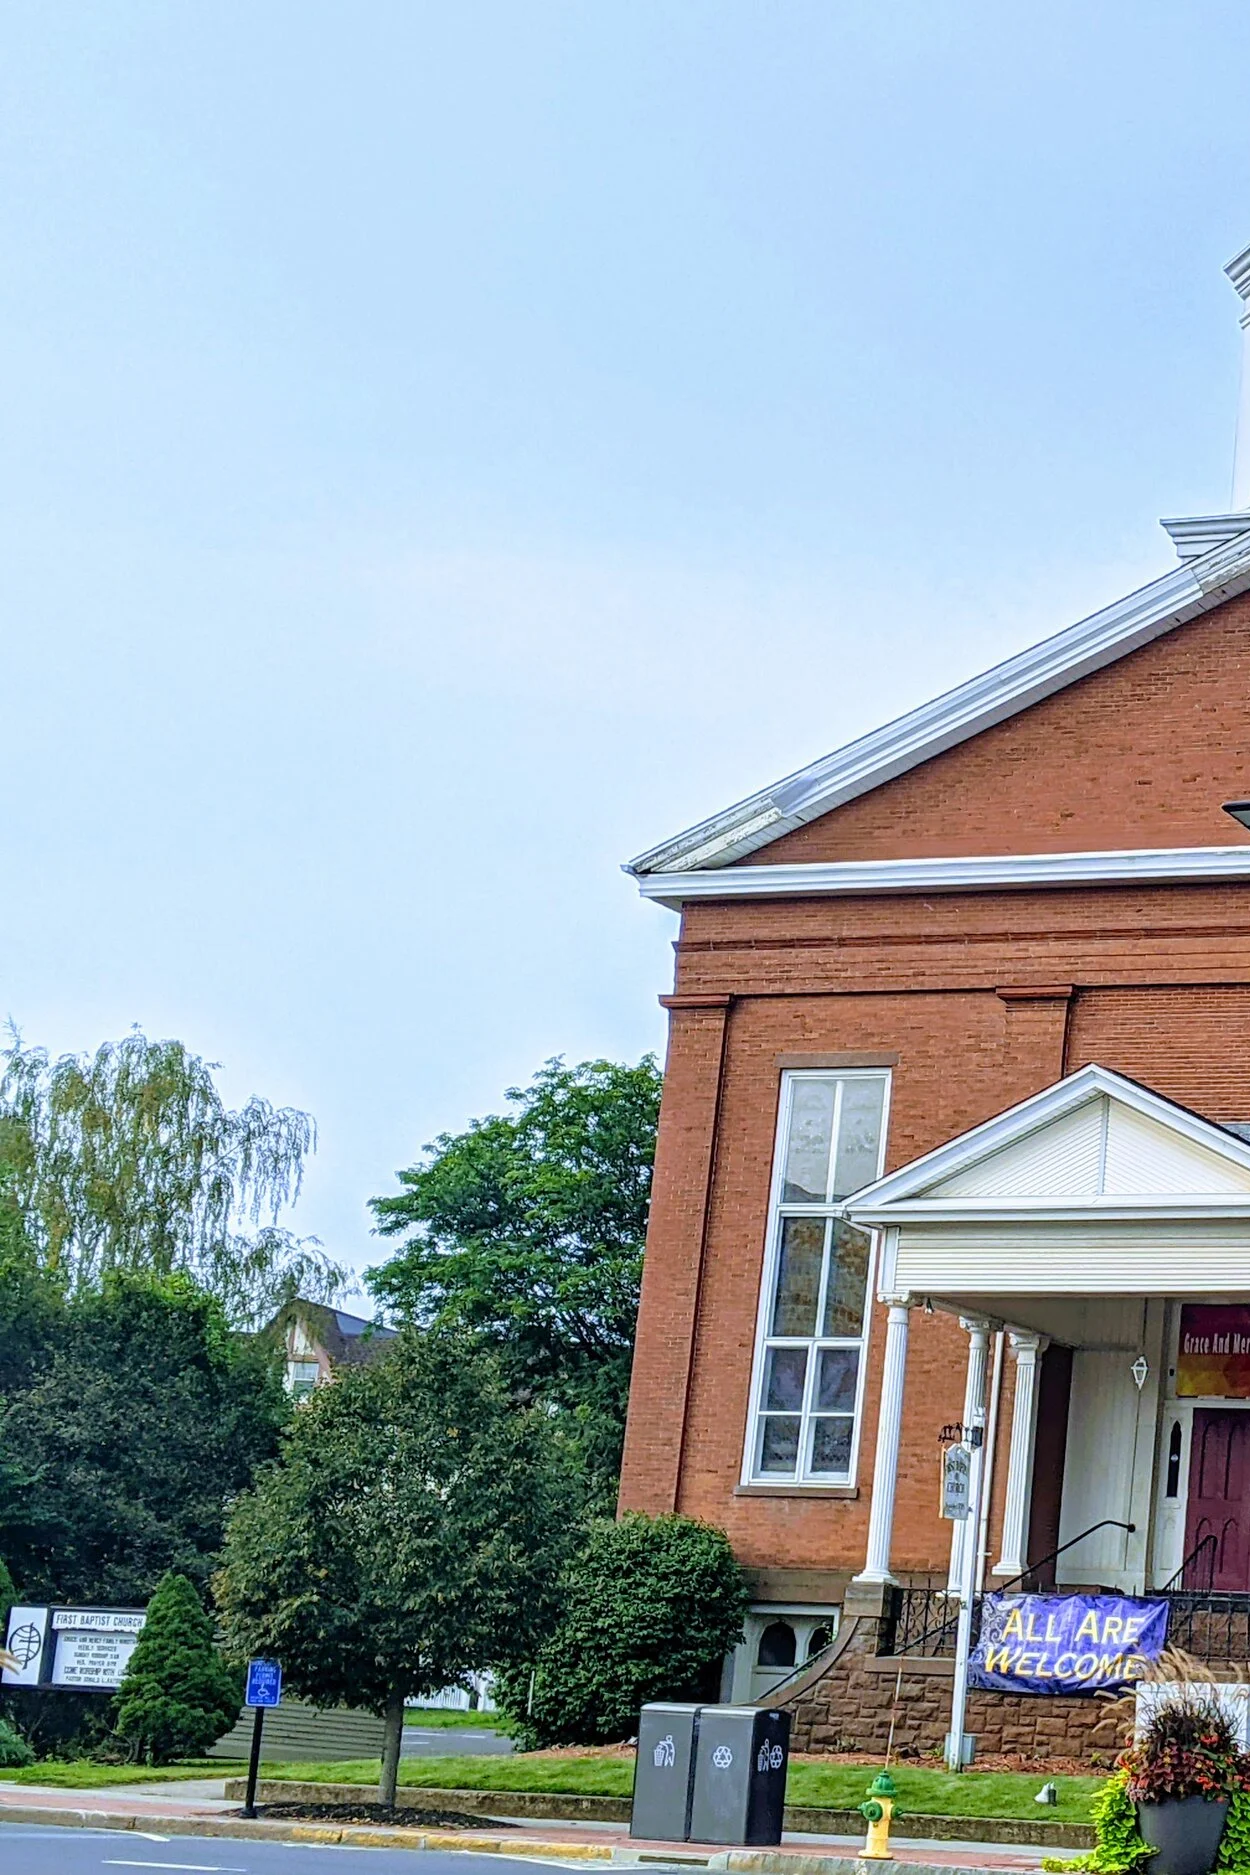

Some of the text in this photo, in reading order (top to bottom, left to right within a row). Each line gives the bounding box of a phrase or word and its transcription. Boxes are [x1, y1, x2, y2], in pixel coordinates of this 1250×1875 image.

[1184, 1333, 1210, 1354] Grace
[1212, 1333, 1230, 1354] And
[56, 1614, 143, 1628] FIRST BAPTIST CHURCH
[1001, 1608, 1146, 1644] ALL ARE
[984, 1646, 1146, 1680] WELCOME
